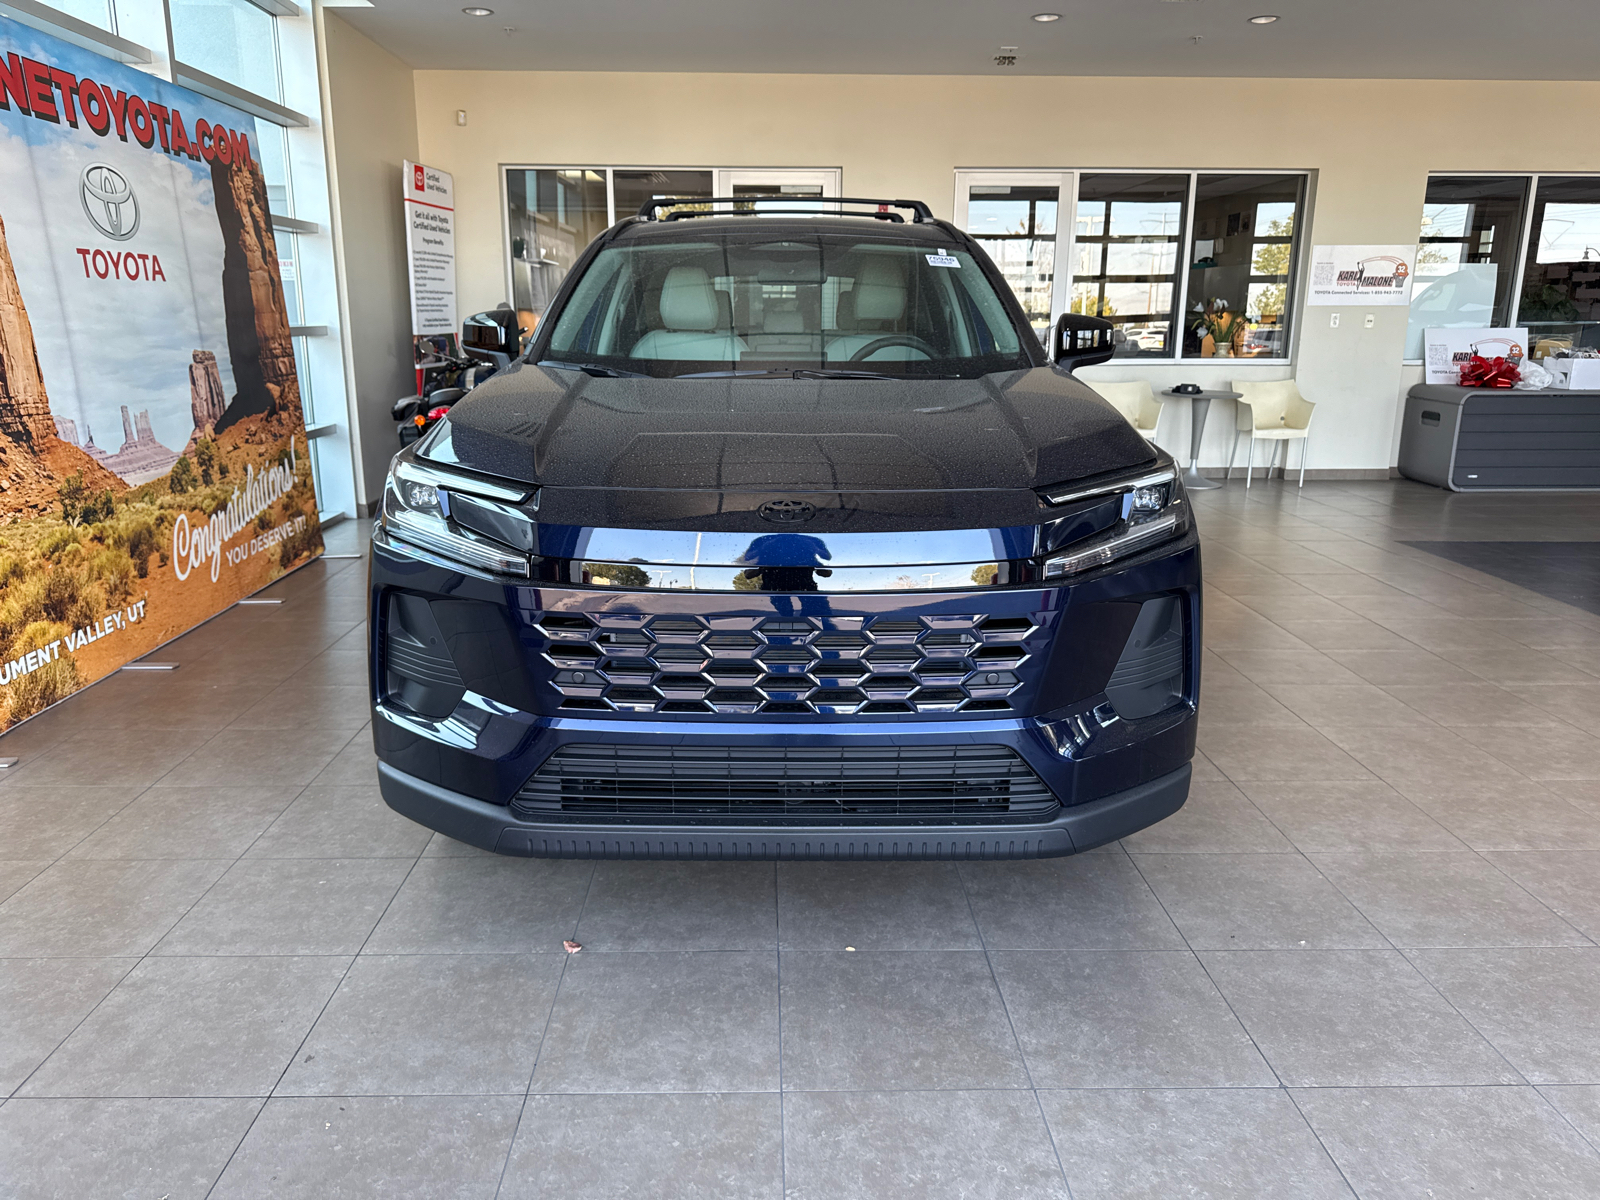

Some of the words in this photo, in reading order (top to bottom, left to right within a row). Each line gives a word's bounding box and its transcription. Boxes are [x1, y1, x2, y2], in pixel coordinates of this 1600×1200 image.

[438, 214, 449, 225] Toyota
[413, 221, 429, 231] Certified
[76, 248, 166, 282] TOYOTA
[1337, 271, 1359, 281] KARL
[1361, 276, 1394, 287] MALONE
[1512, 346, 1519, 354] 32
[173, 434, 299, 583] Congratulations!
[226, 543, 248, 567] YOU
[250, 521, 295, 555] DESERVE
[294, 515, 307, 534] IT!
[0, 640, 61, 685] UMENT
[64, 611, 126, 653] VALLEY,
[127, 600, 145, 622] UT
